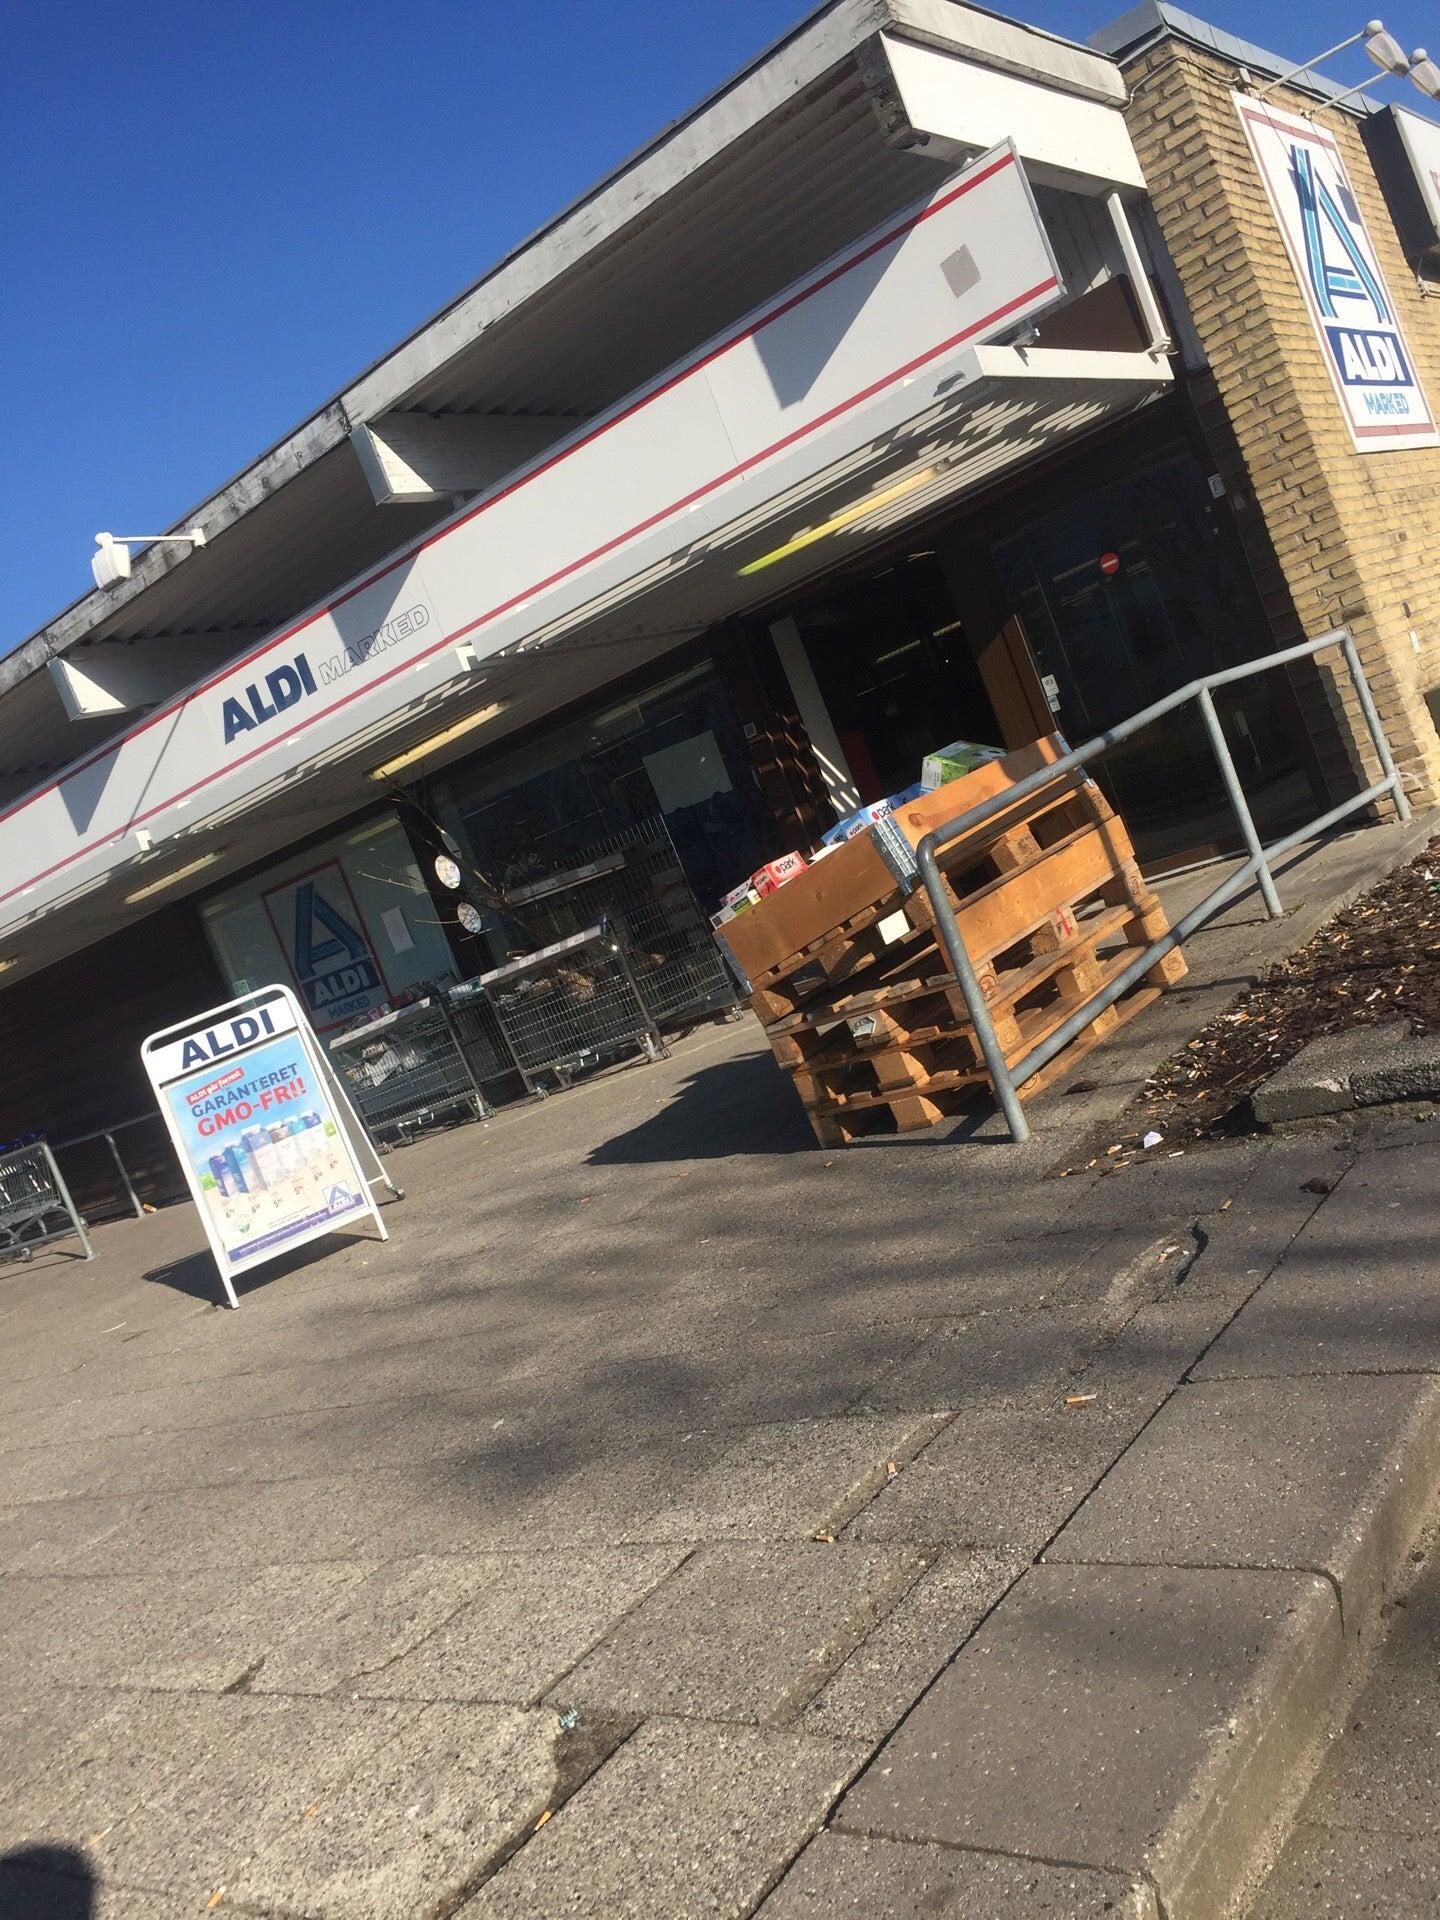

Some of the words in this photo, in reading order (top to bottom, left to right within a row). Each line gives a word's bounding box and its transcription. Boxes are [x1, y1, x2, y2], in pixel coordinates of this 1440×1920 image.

[1338, 332, 1406, 382] ALDI
[1362, 391, 1410, 415] MARKED
[222, 652, 318, 746] ALDI
[318, 604, 430, 686] MARKED
[780, 856, 798, 874] park
[314, 964, 371, 1004] ALDI
[182, 1008, 276, 1070] ALDI
[189, 1089, 207, 1103] ALDI
[191, 1062, 298, 1118] GARANTERET
[197, 1077, 306, 1137] GMO-FRI!
